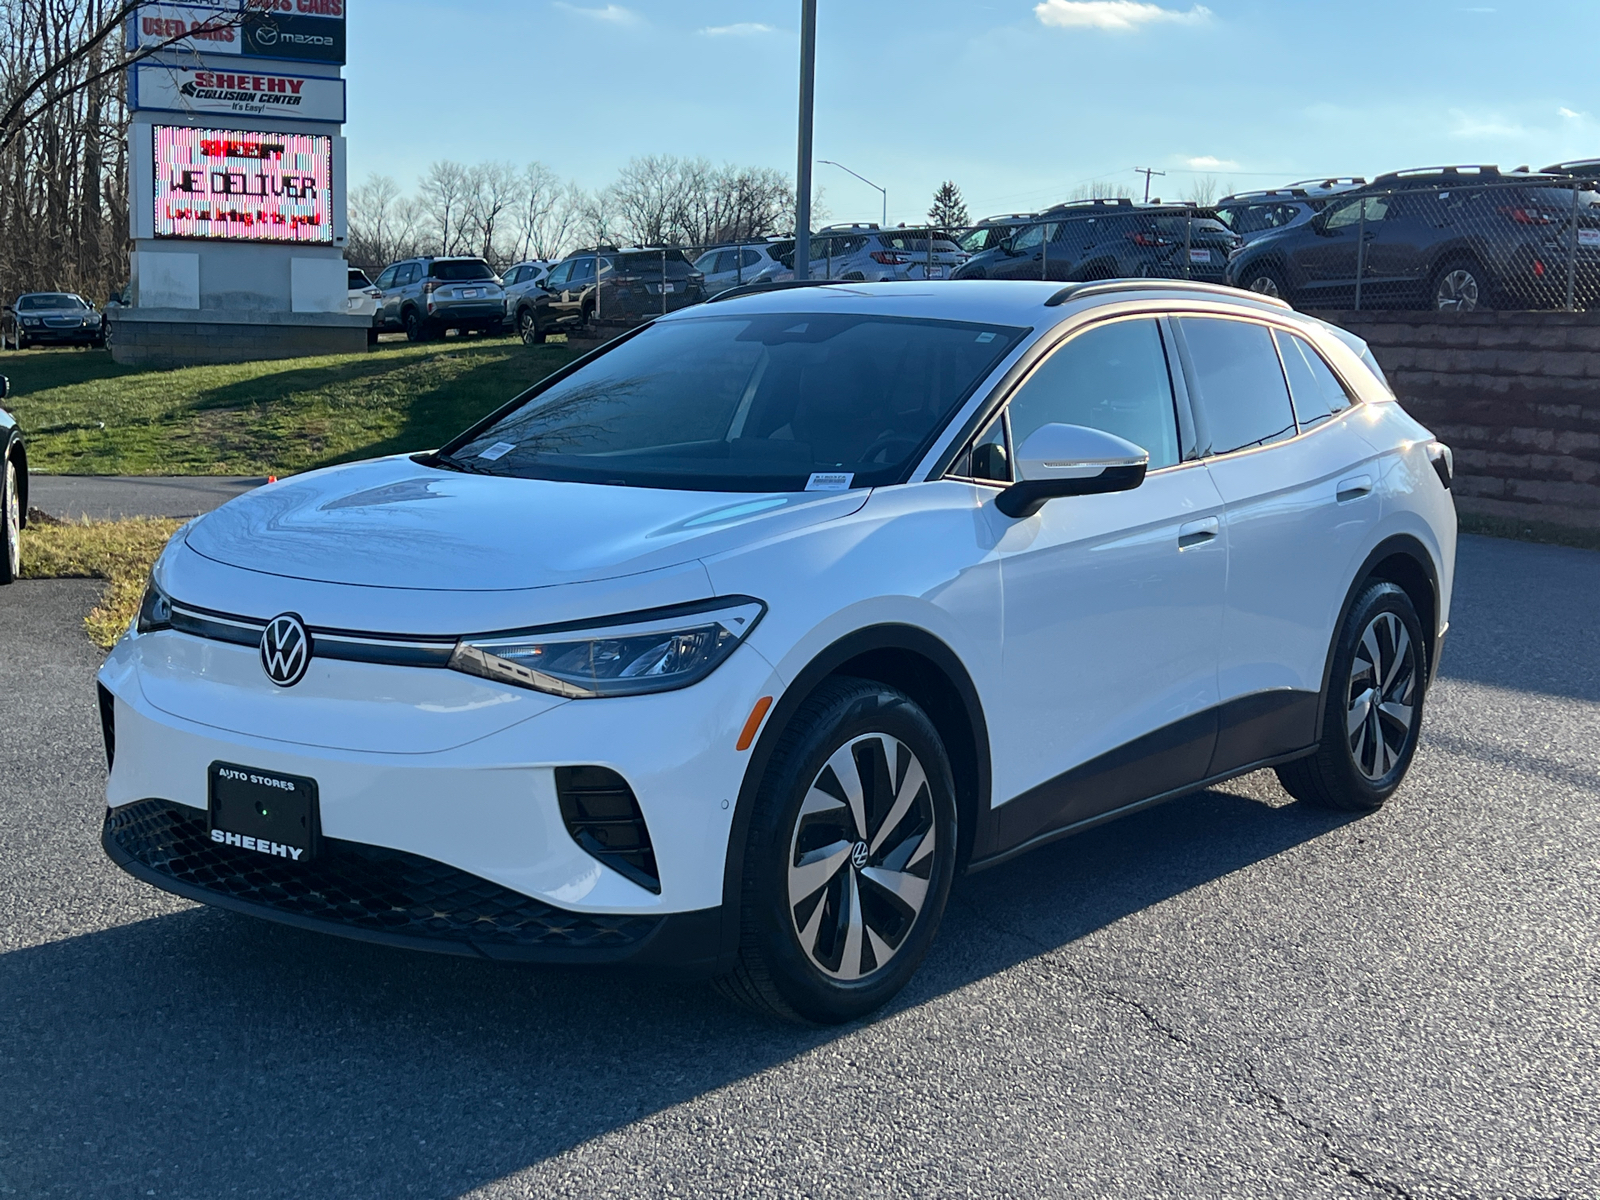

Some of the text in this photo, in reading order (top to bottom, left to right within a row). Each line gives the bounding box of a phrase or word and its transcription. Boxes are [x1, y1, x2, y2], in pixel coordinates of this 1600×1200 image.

[142, 17, 187, 38] USED
[195, 72, 304, 94] SHEEHY
[195, 89, 302, 106] COLLISION CENTER
[231, 102, 265, 114] It's Easy!
[219, 768, 295, 791] AUTO STORES
[211, 829, 303, 860] SHEEHY
